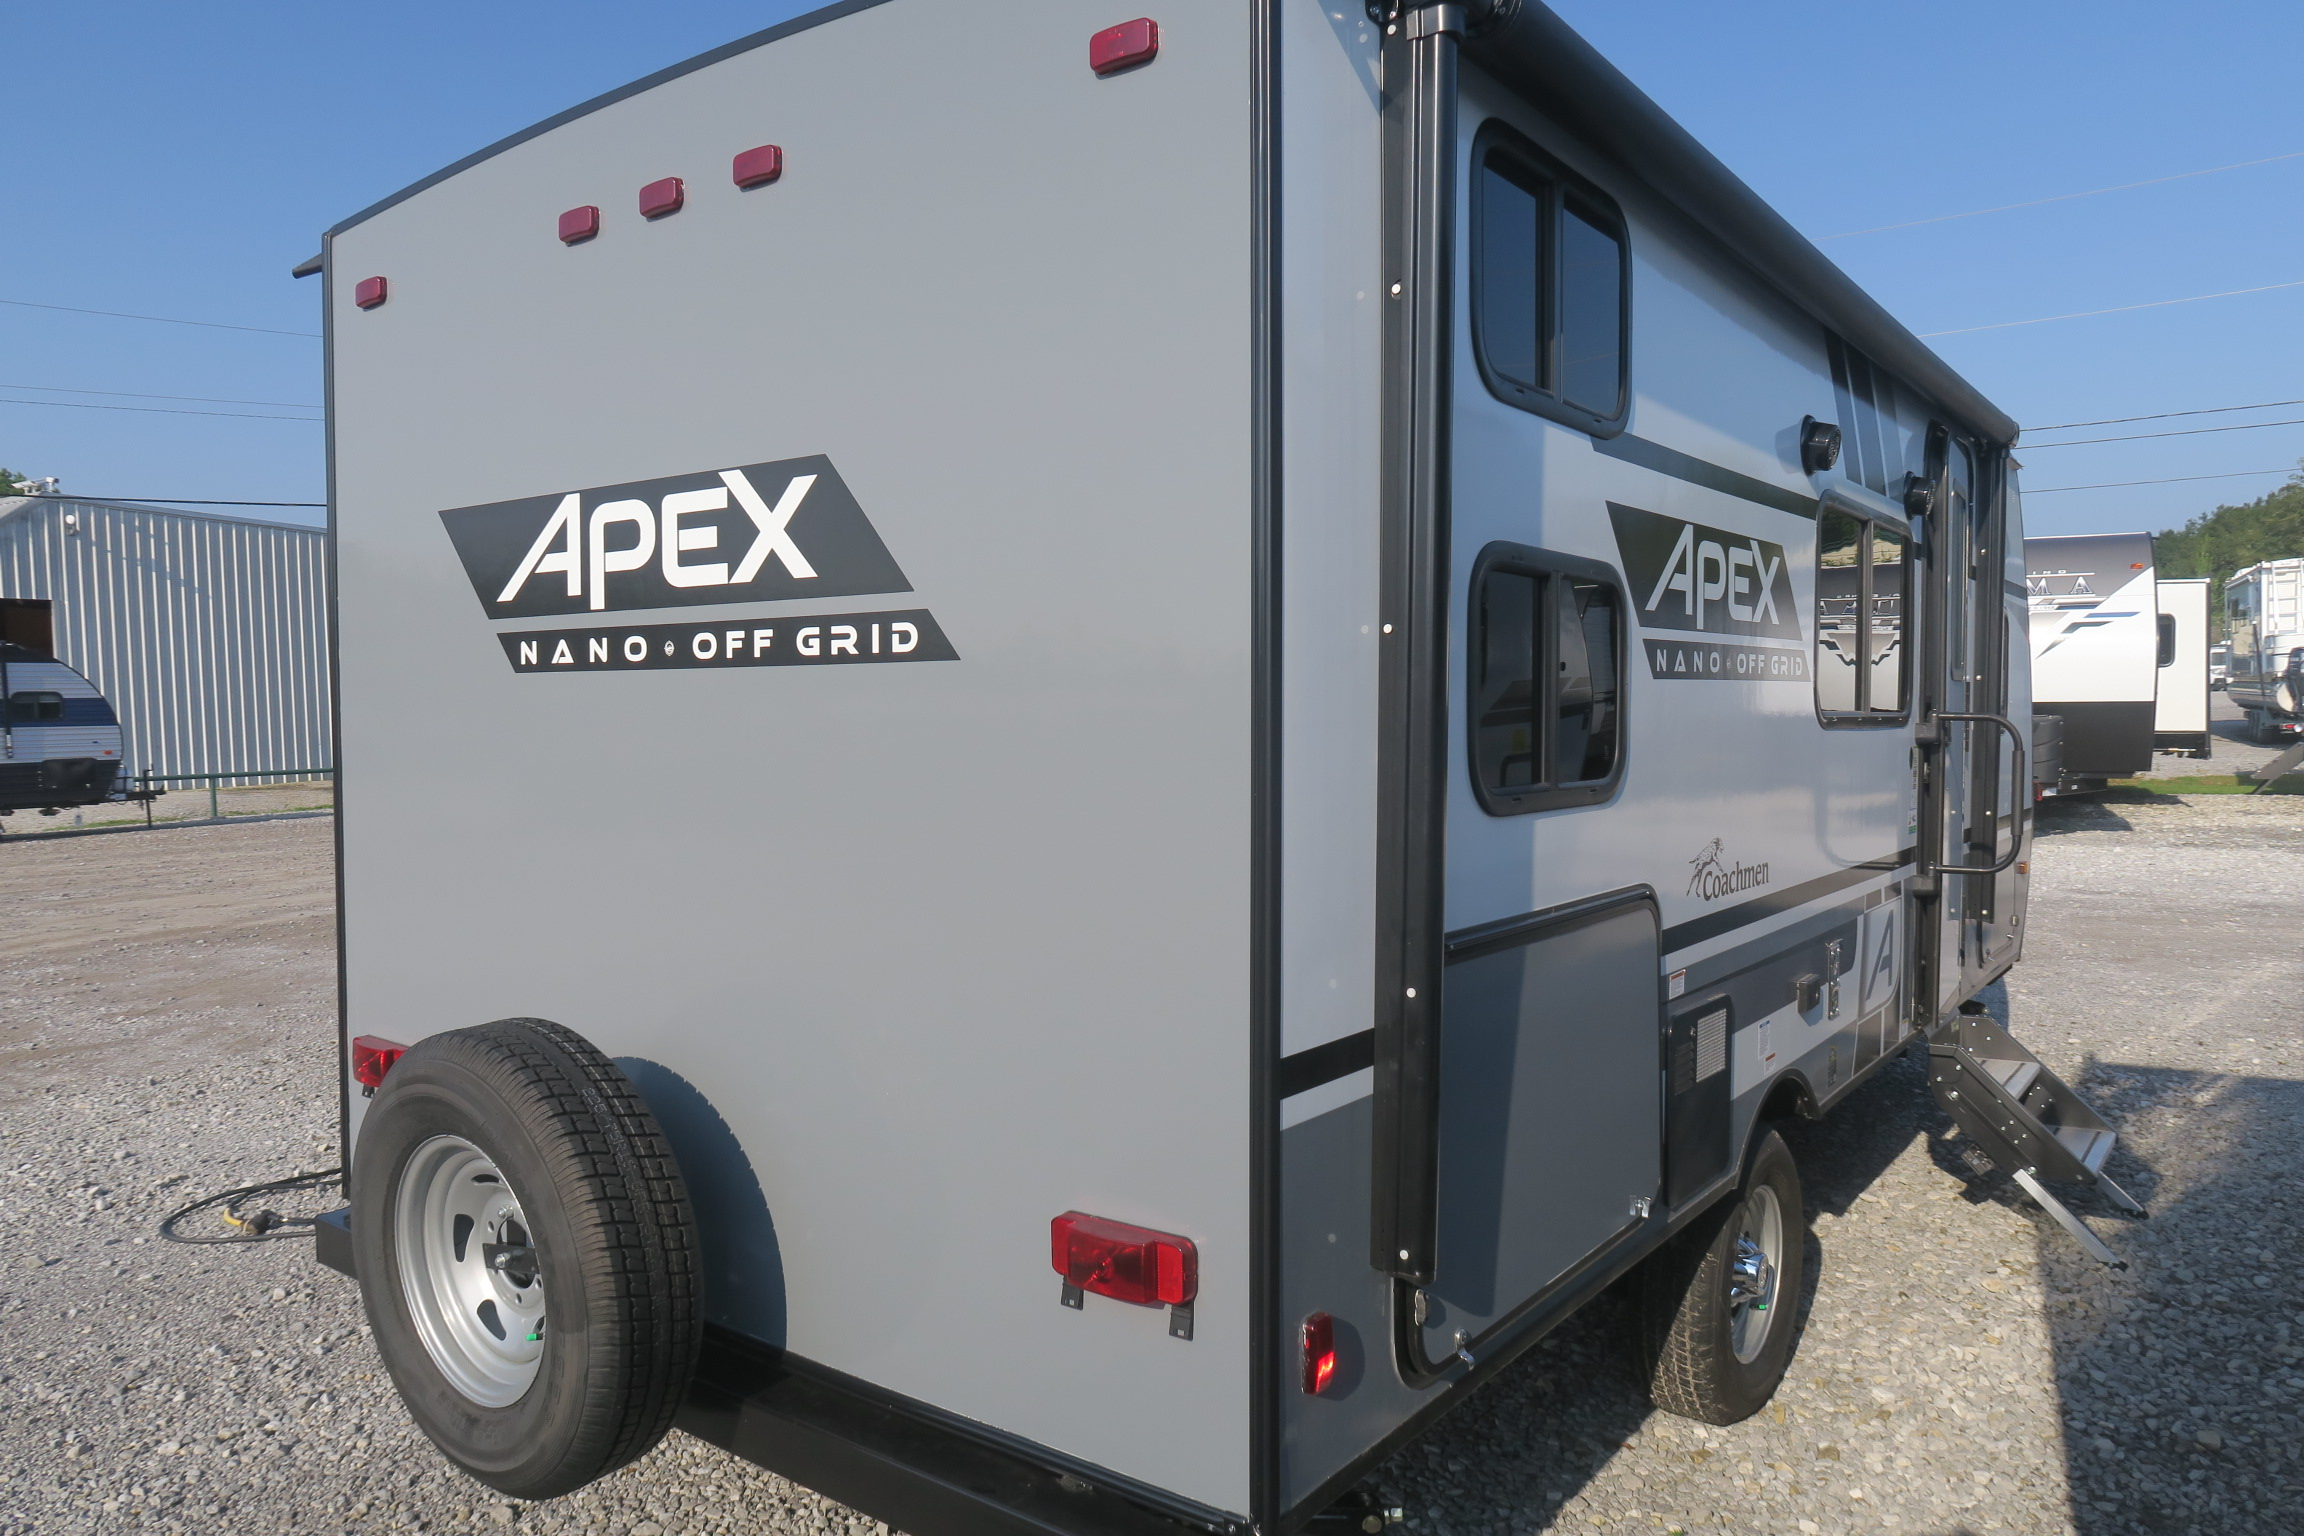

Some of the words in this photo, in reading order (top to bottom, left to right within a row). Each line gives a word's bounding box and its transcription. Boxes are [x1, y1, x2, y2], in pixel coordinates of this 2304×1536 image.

[496, 468, 818, 611] APEX
[1645, 523, 1780, 630] APEX
[520, 634, 648, 666] NANO
[692, 629, 774, 659] OFF
[796, 621, 919, 656] GRID
[1656, 649, 1721, 673] NANO
[1737, 652, 1765, 674] OFF
[1771, 654, 1803, 676] GRID
[1702, 861, 1769, 901] Coachmen
